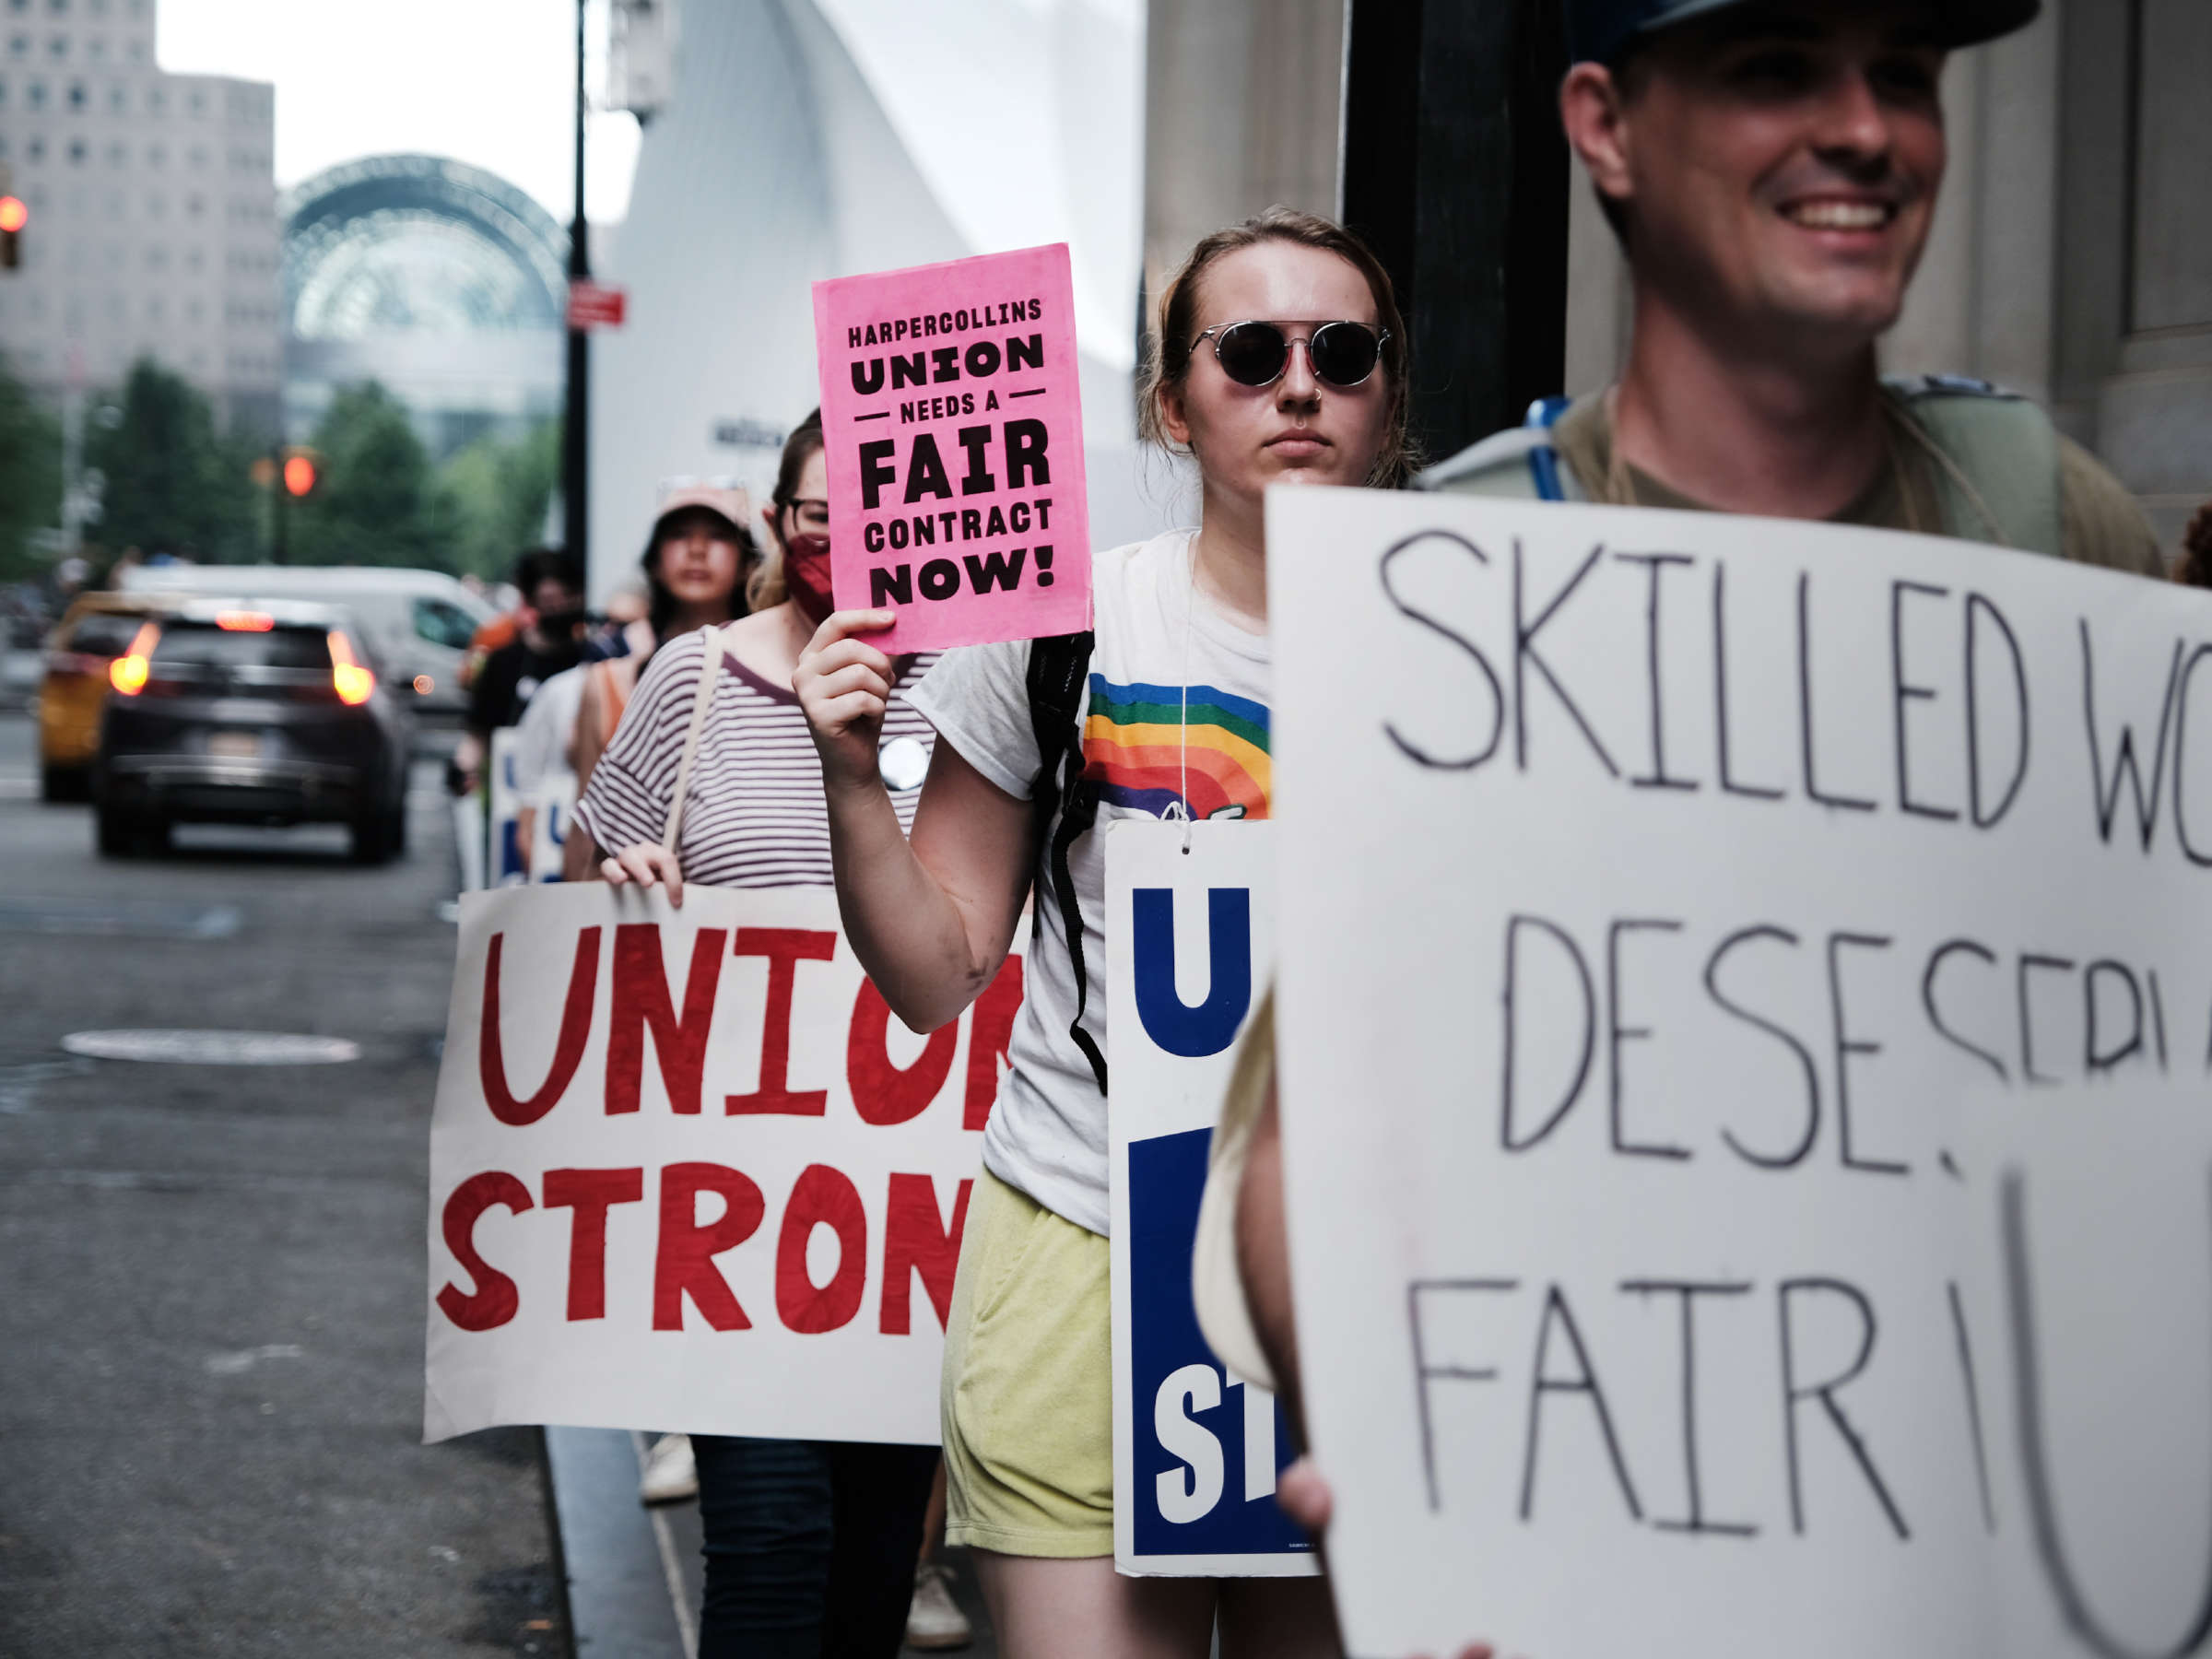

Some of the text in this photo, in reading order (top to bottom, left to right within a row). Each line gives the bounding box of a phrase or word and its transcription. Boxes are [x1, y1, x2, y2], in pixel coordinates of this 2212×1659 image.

[848, 299, 1041, 348] HARPERCOLLINS
[851, 334, 1045, 395] UNION
[900, 390, 1000, 424] NEEDS A
[859, 418, 1052, 510] FAIR
[864, 499, 1053, 553] CONTRACT
[869, 545, 1055, 608] NOW!
[1380, 530, 2030, 830] SKILLED
[1133, 888, 1252, 1058] U
[1407, 1277, 1912, 1541] FAIR
